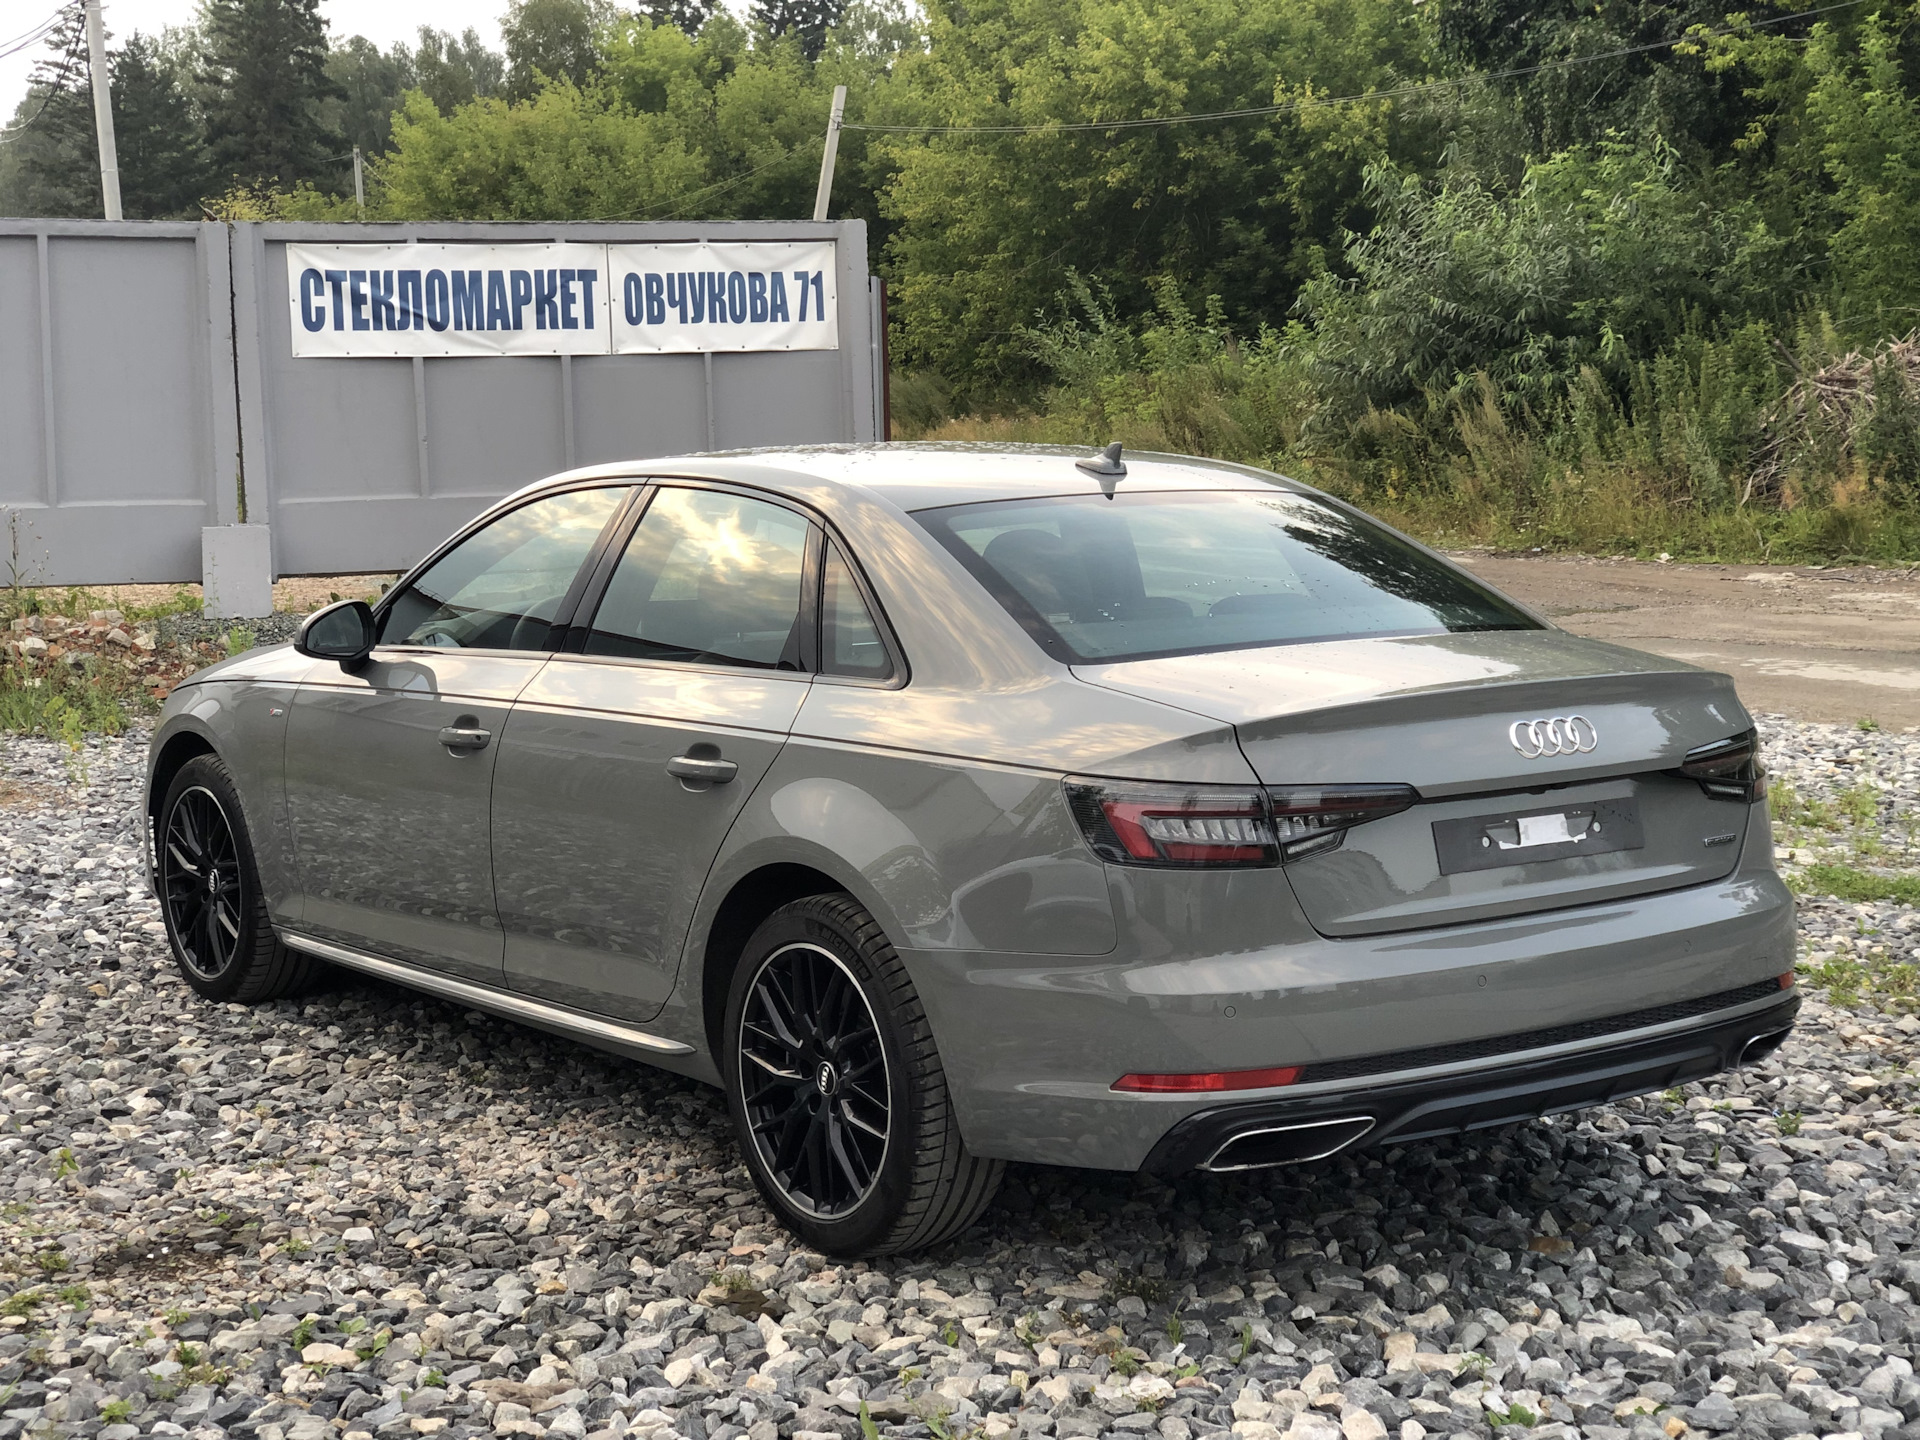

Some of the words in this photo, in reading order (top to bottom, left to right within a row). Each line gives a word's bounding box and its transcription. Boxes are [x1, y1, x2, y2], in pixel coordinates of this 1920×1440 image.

[300, 268, 598, 332] СТЕКЛОМАРКЕТ
[624, 270, 790, 326] ОВЧУКОВА
[794, 270, 825, 322] 71
